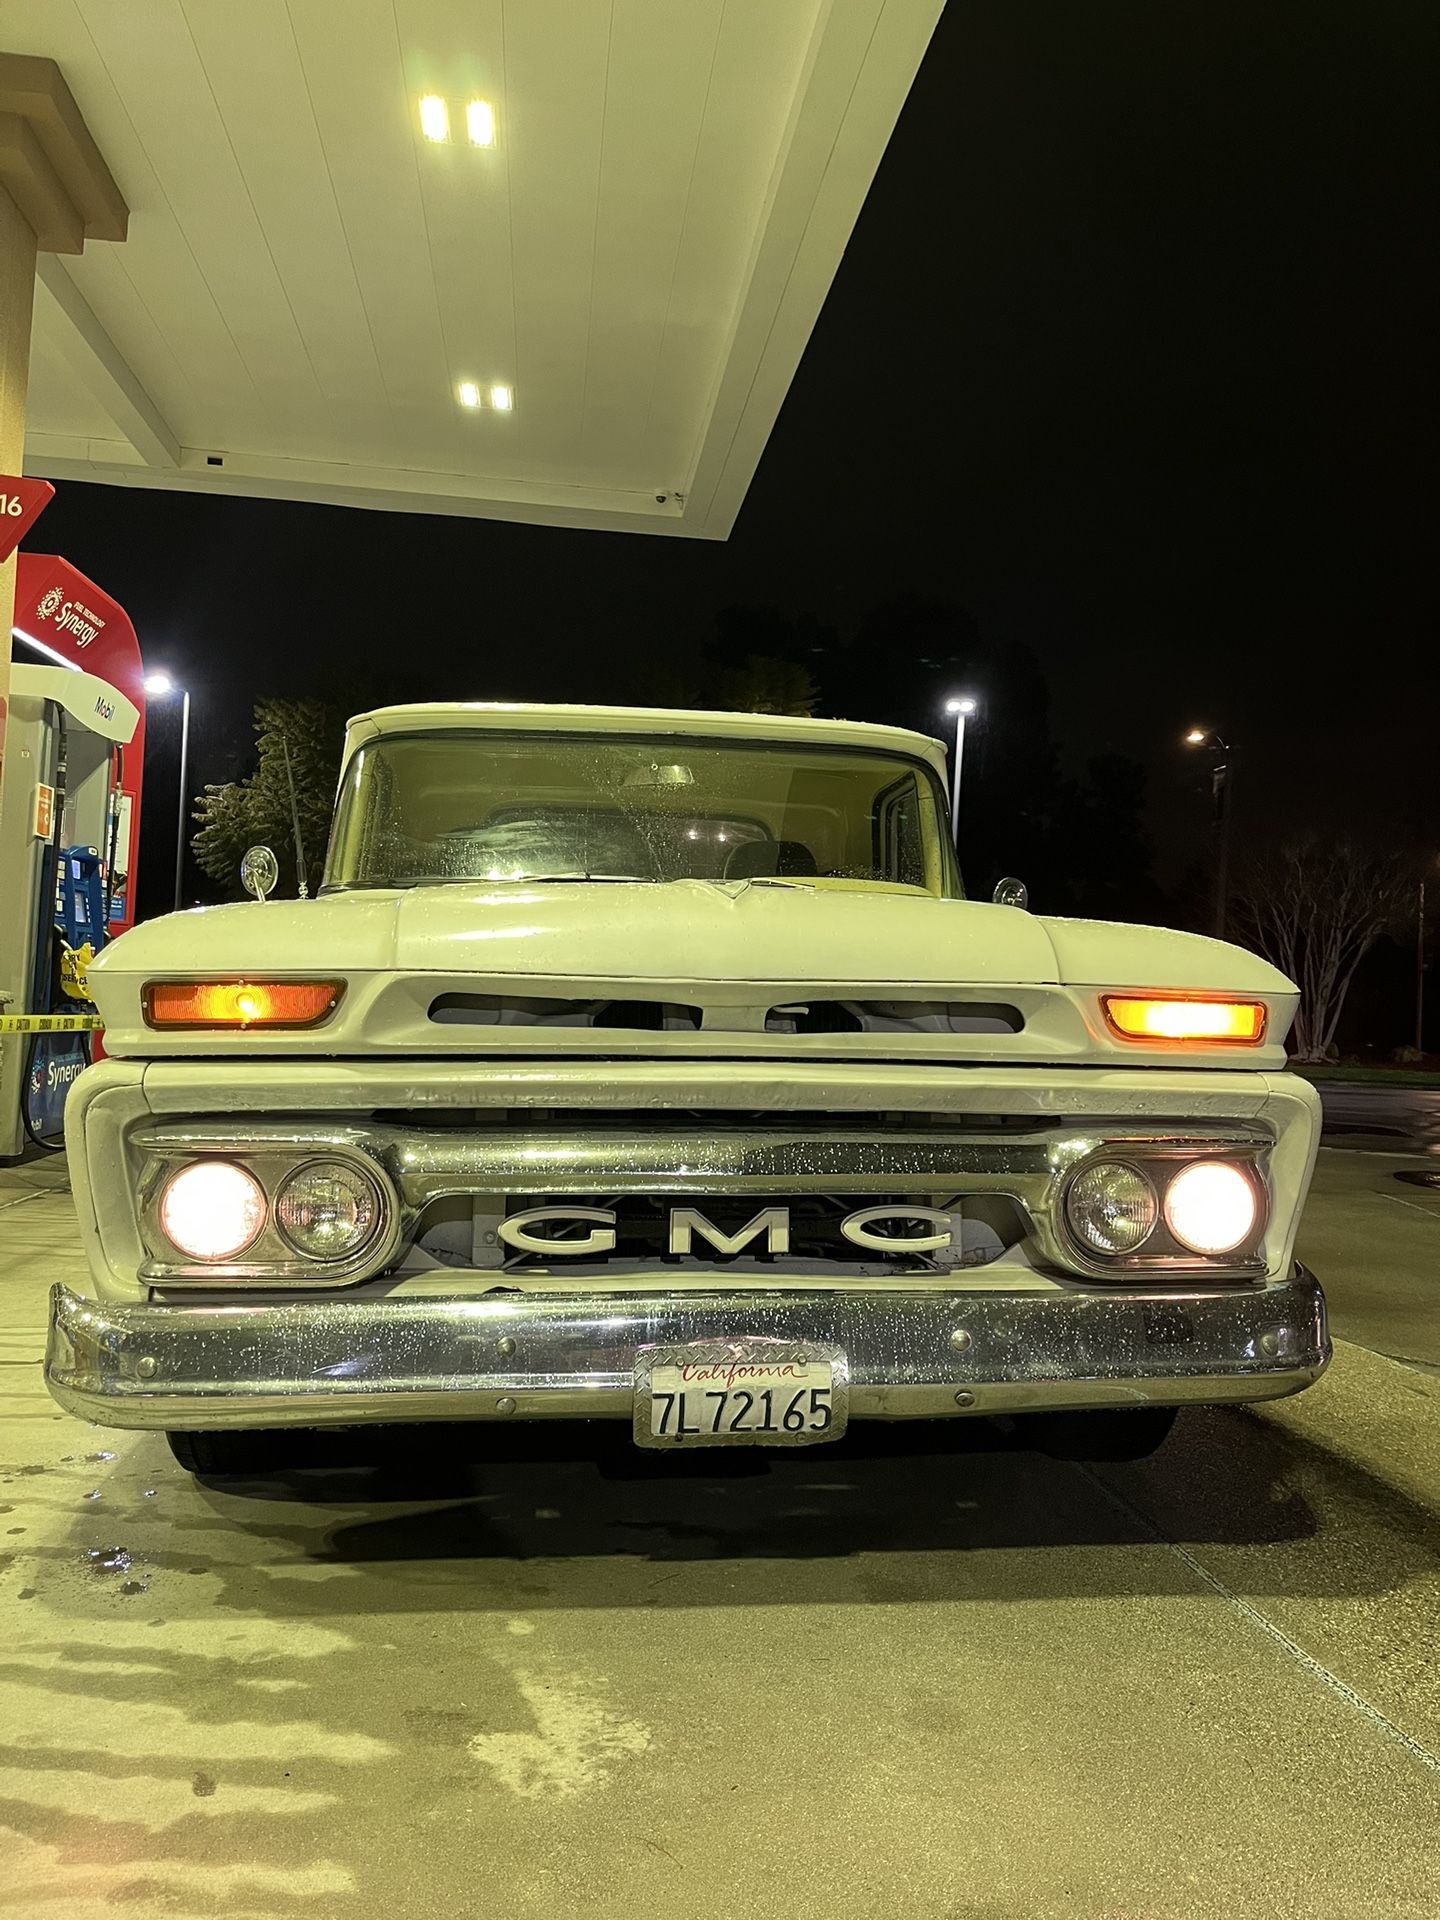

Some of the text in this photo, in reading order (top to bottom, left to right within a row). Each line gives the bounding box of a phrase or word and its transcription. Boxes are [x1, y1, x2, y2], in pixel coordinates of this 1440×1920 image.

[0, 493, 23, 517] 16
[54, 601, 99, 649] Synergy
[73, 601, 107, 629] FUEL TECHNOLOGY
[94, 696, 115, 722] Mobil
[681, 1363, 809, 1389] California
[652, 1388, 832, 1435] 7L72165
